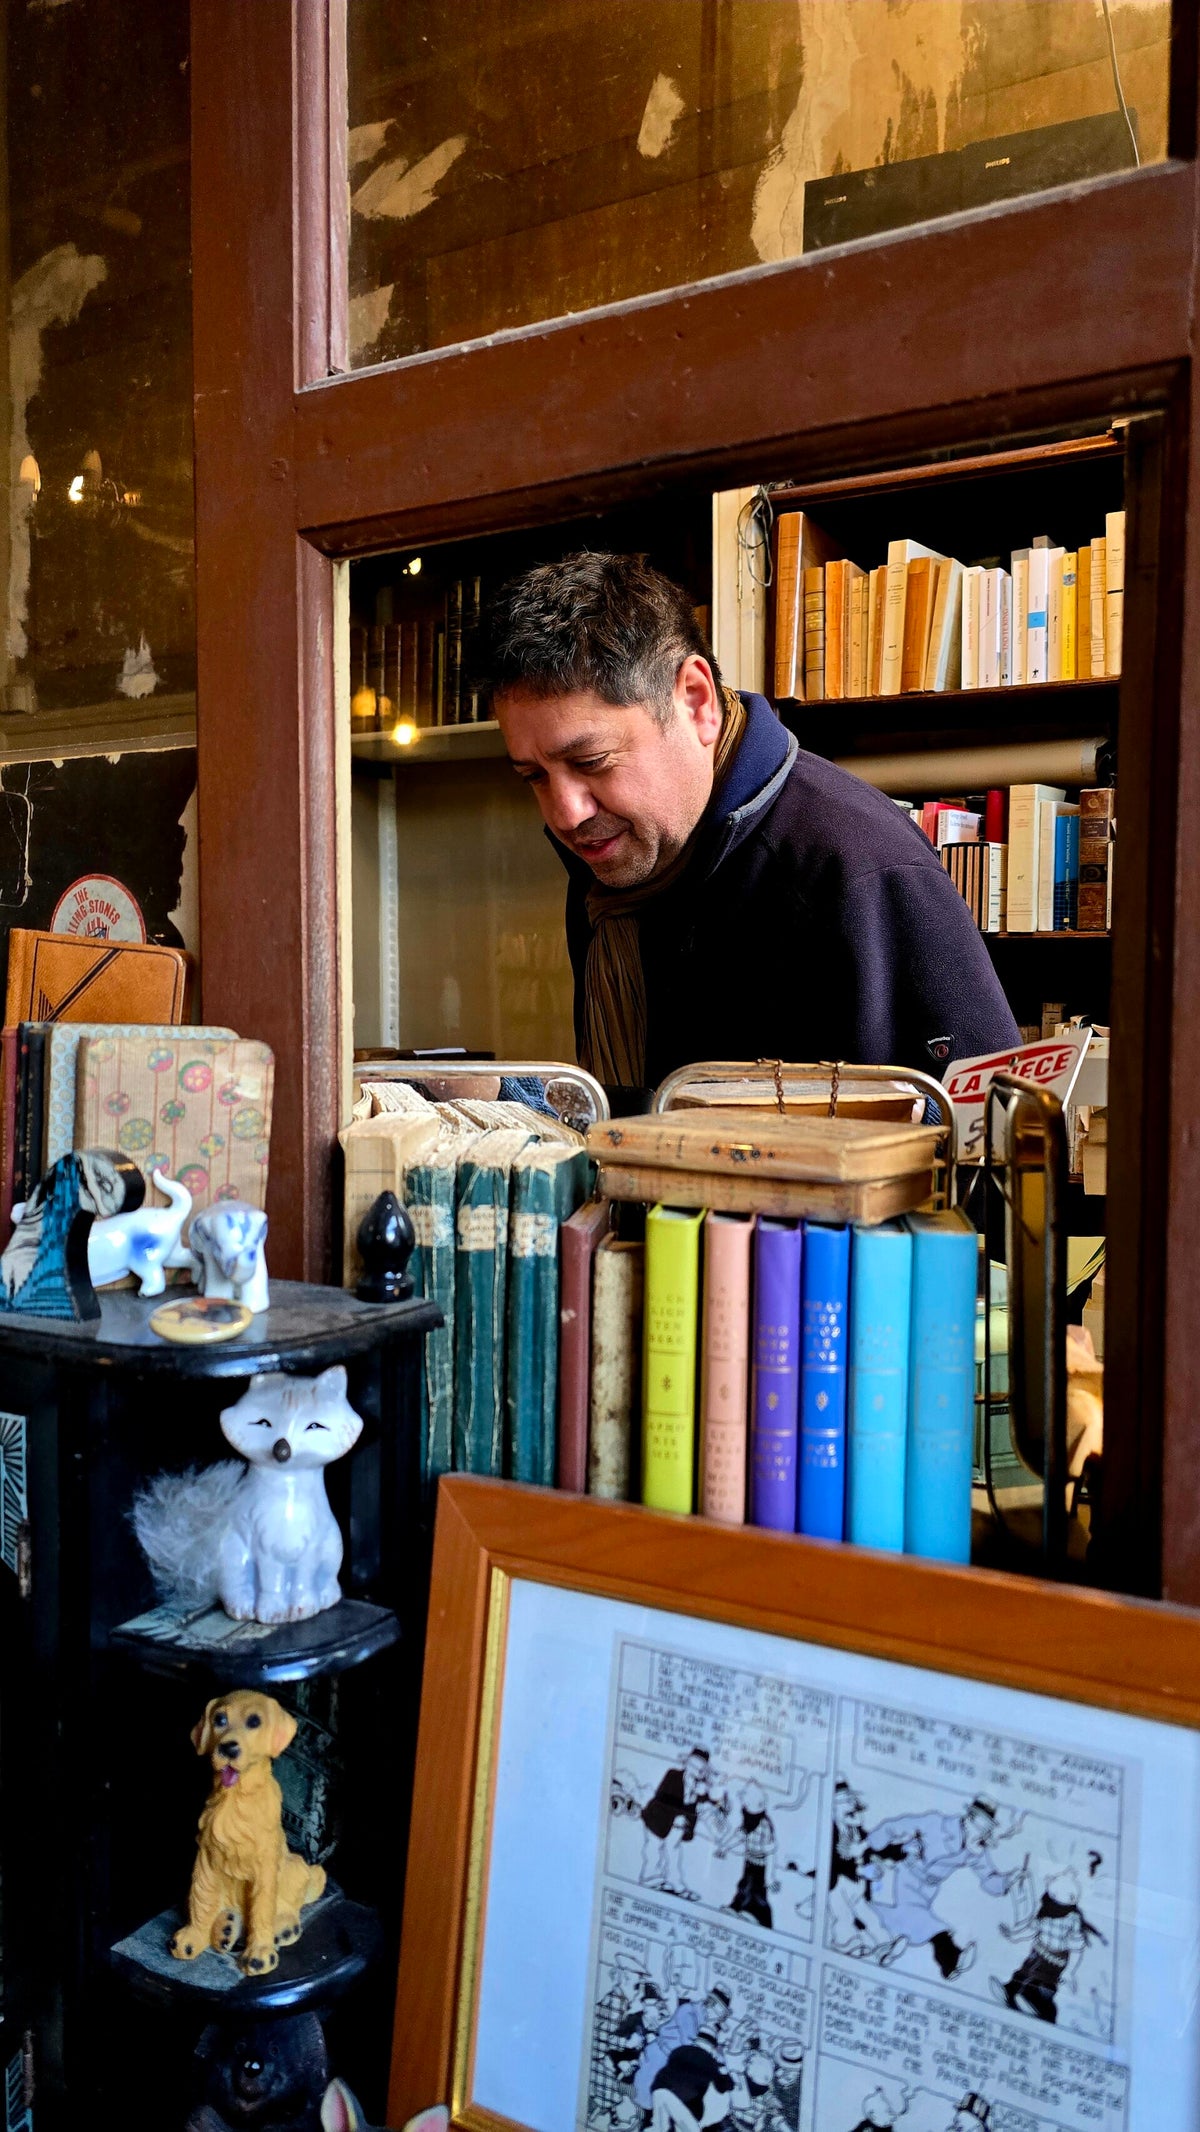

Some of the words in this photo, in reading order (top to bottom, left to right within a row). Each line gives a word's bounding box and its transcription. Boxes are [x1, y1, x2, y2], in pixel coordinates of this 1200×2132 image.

[985, 157, 1010, 169] PHILIPS
[73, 887, 89, 906] THE
[67, 904, 88, 935] LLING
[88, 899, 121, 926] STONES
[948, 1074, 982, 1095] LA
[757, 1975, 807, 2006] DOLLARS
[824, 2012, 854, 2036] DES
